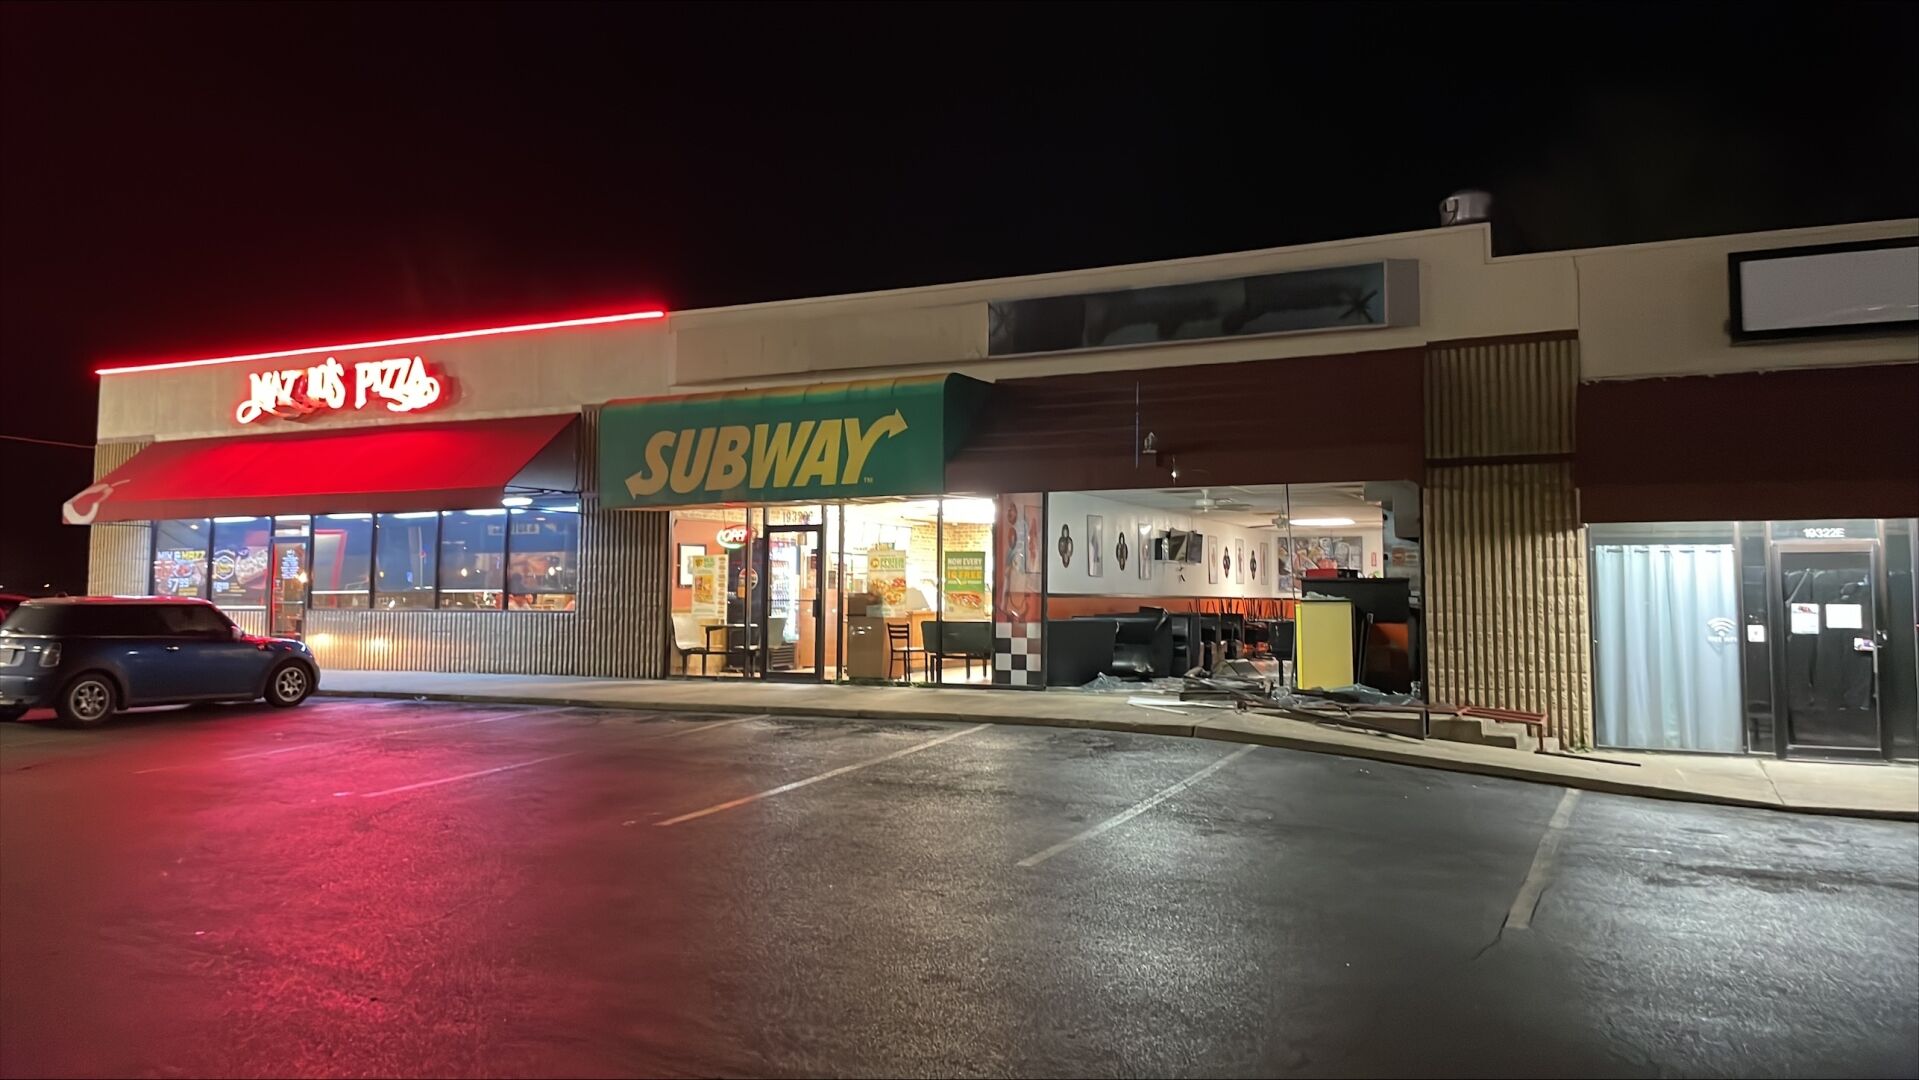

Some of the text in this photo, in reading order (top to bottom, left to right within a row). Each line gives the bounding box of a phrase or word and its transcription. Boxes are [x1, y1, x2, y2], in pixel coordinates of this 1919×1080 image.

[355, 356, 440, 412] PIZZA
[624, 408, 908, 500] SUBWAY
[1802, 528, 1846, 538] 19322E
[962, 558, 982, 566] EVERY
